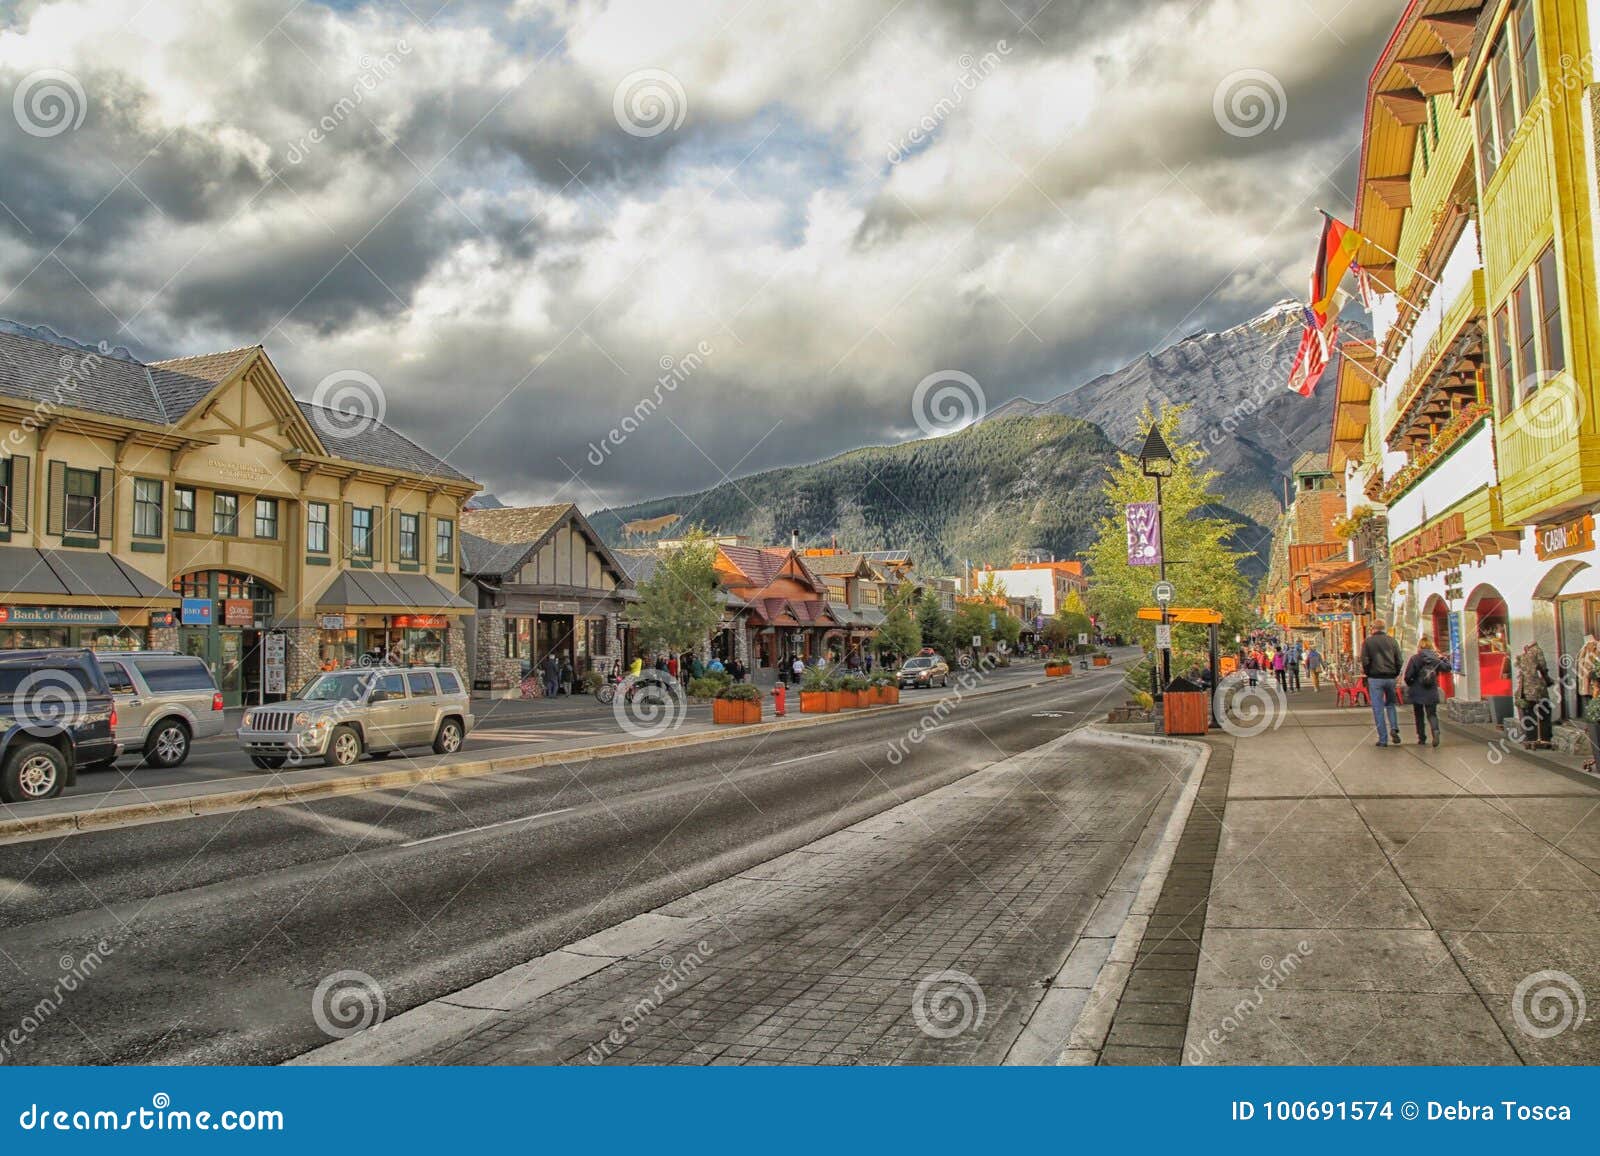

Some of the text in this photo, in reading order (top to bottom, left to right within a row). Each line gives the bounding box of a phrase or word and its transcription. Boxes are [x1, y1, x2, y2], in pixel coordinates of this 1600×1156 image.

[13, 609, 103, 621] Bank of Montreal
